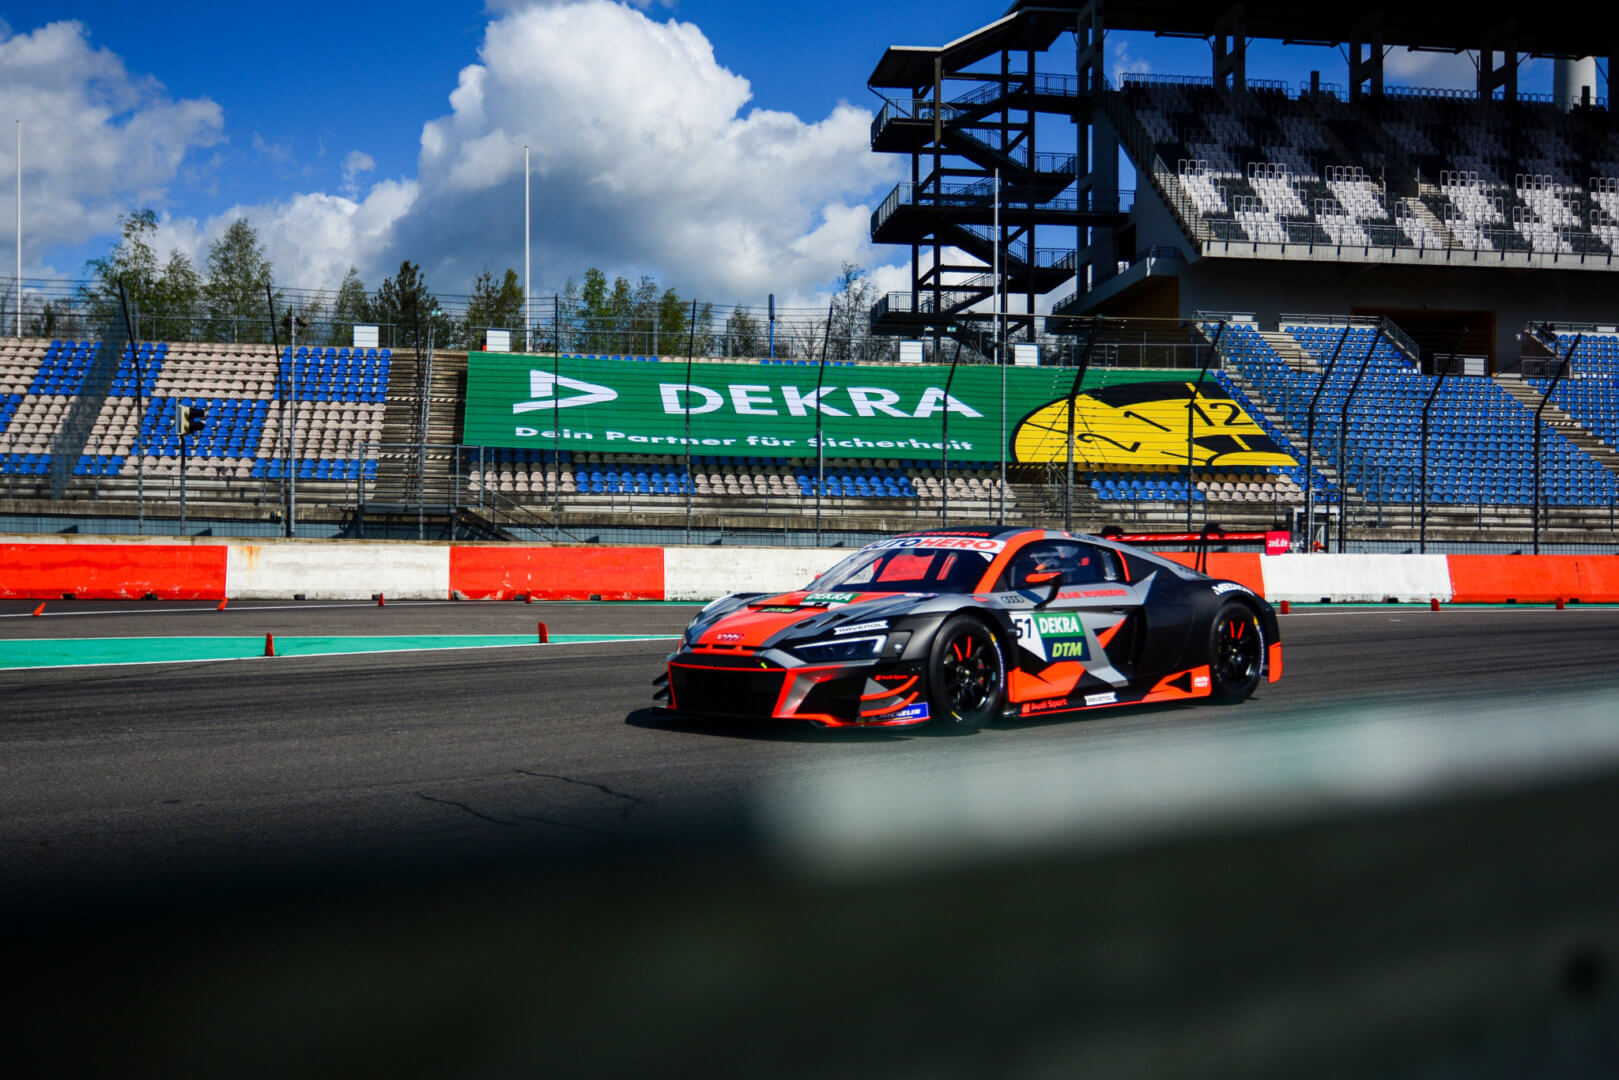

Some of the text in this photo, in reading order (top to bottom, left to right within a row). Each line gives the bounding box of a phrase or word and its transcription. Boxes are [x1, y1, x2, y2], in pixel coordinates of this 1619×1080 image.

[659, 383, 985, 418] DEKRA
[515, 427, 974, 450] Dein Partner für Sicherheit
[1014, 618, 1032, 639] 51
[1039, 616, 1080, 634] DEKRA
[1052, 642, 1083, 658] DTM
